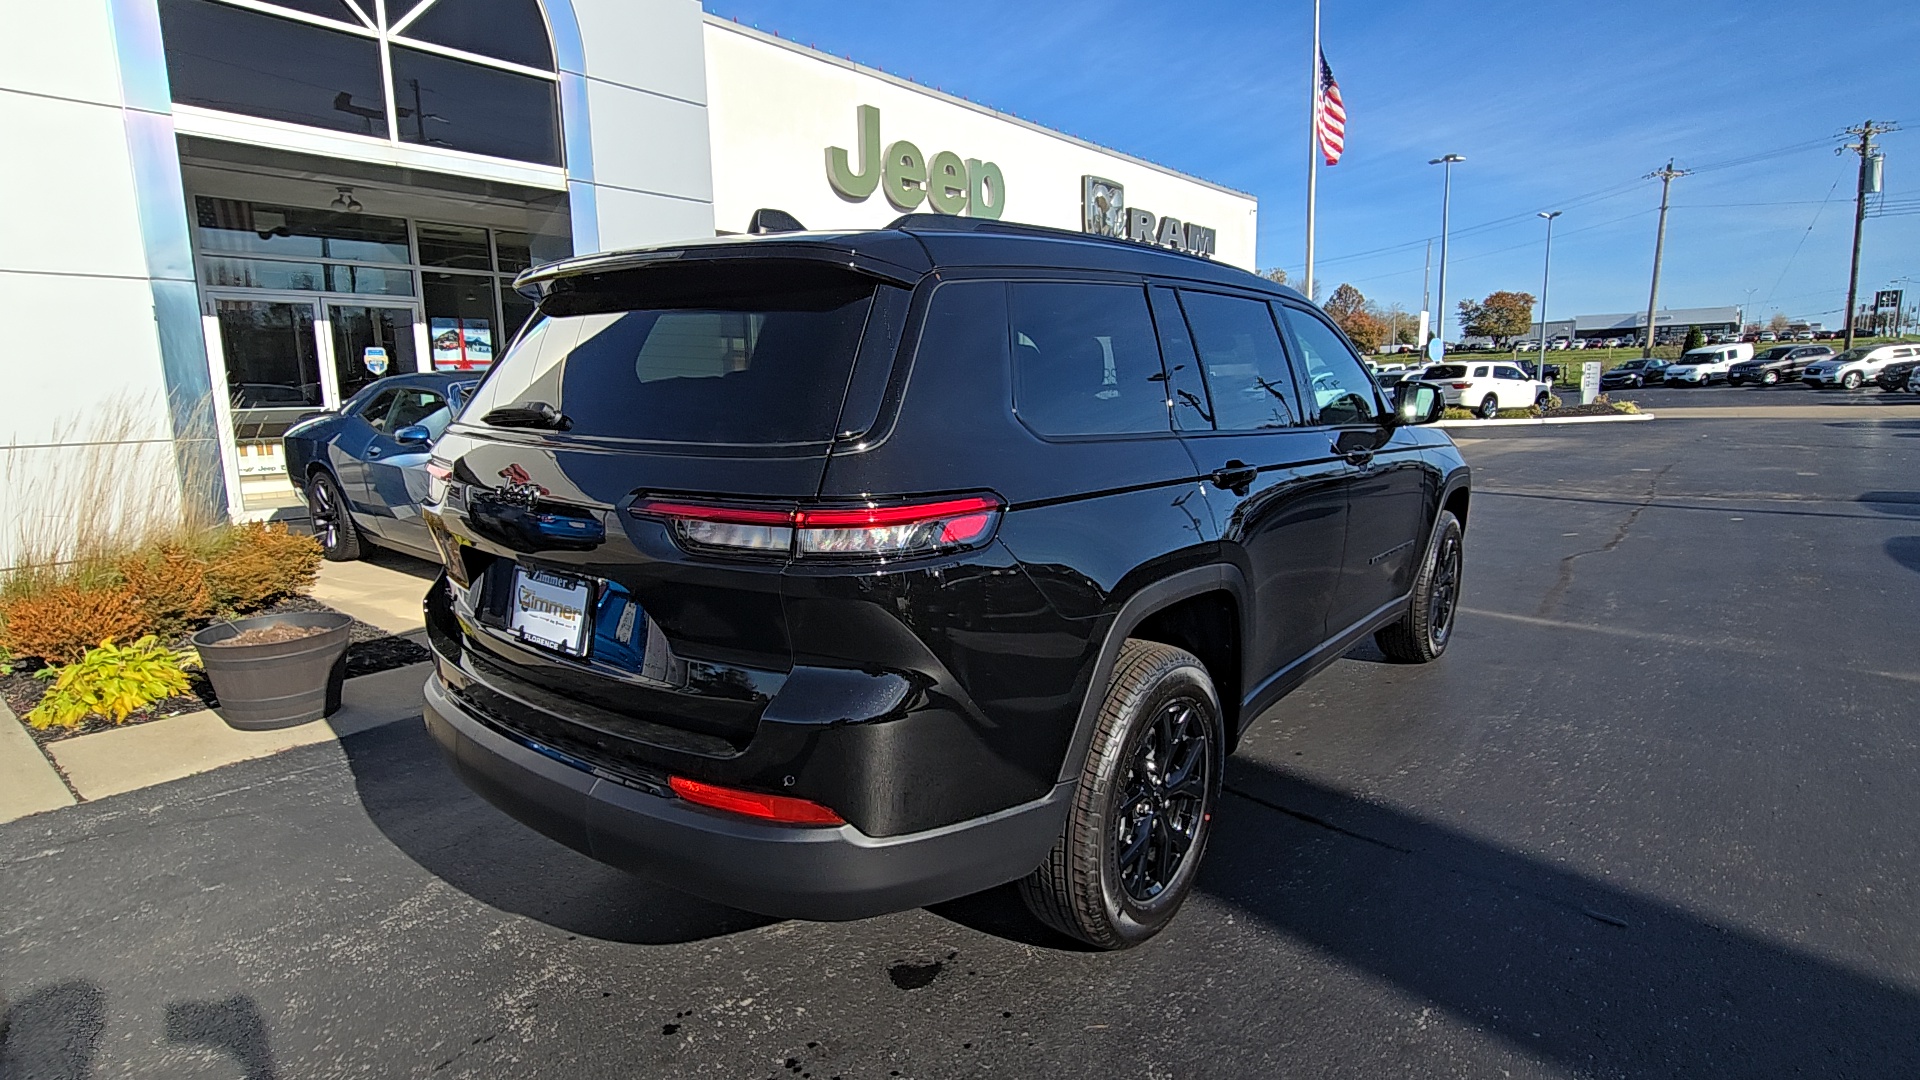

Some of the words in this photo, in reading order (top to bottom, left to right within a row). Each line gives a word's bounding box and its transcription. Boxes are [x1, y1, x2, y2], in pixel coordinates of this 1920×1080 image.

[824, 104, 1006, 219] Jeep
[1125, 207, 1217, 256] RAM
[532, 570, 568, 588] Zimmer
[521, 587, 583, 621] Zimmer
[523, 633, 559, 650] FLORENCE
